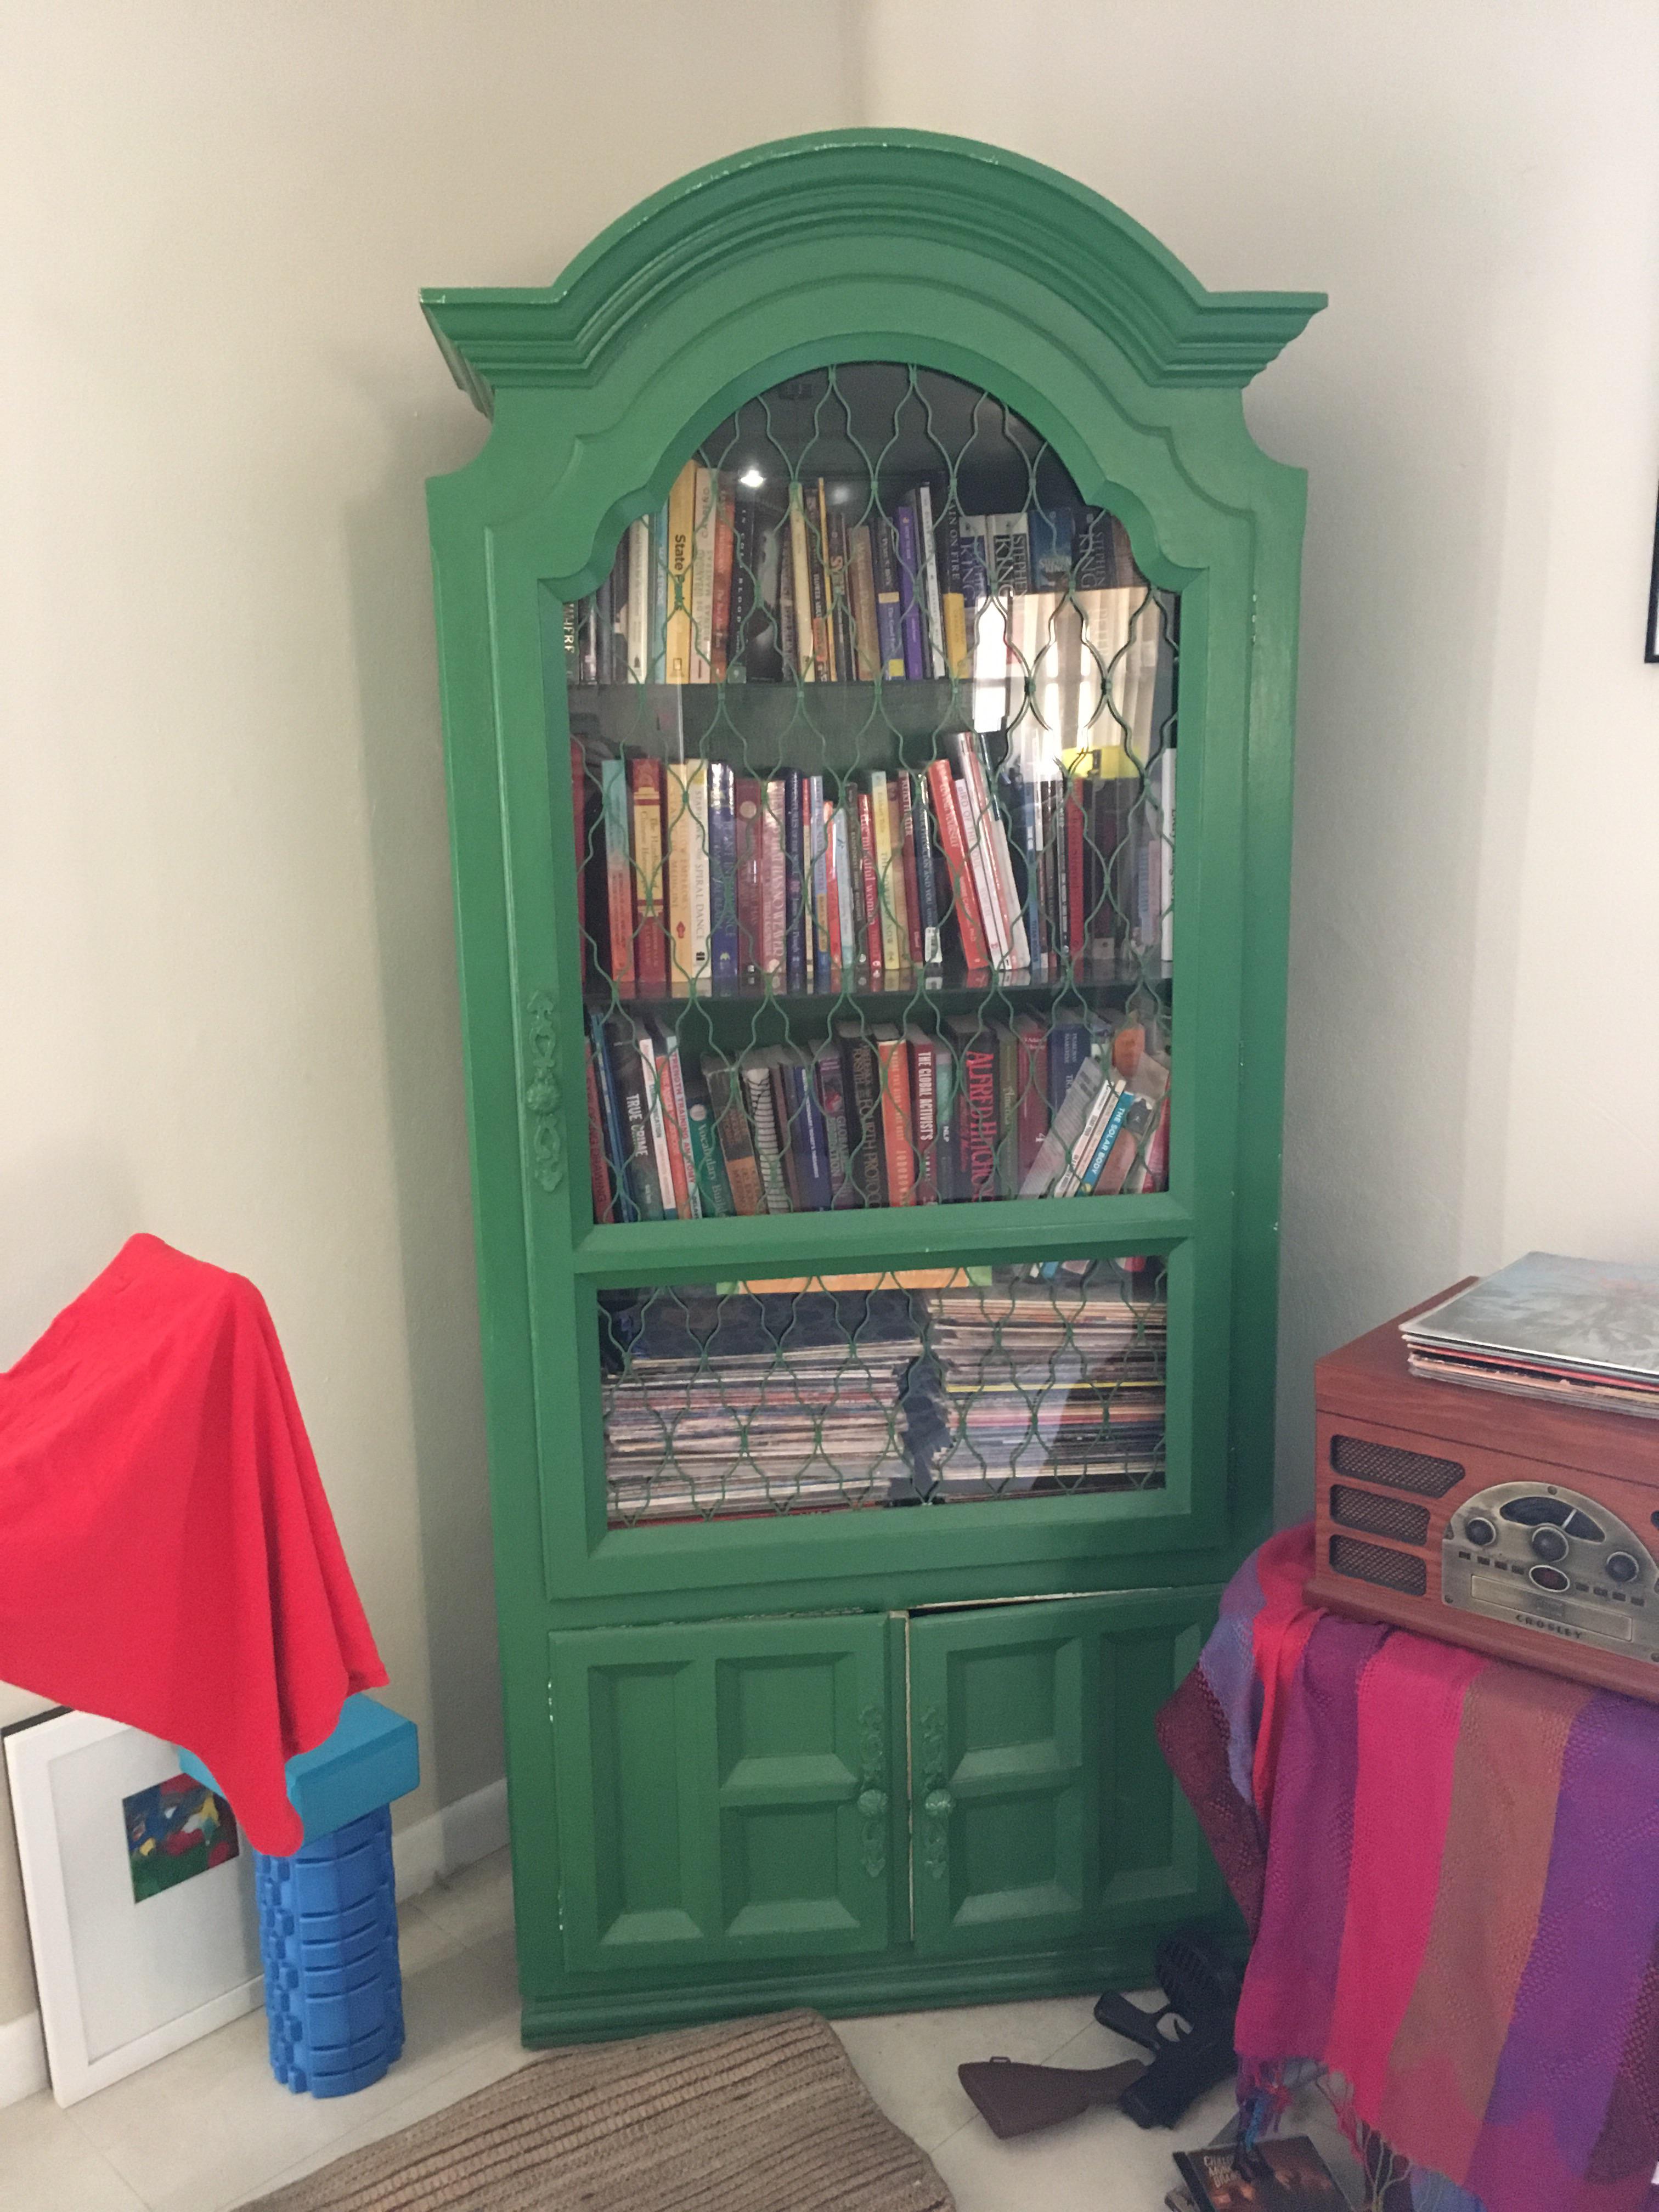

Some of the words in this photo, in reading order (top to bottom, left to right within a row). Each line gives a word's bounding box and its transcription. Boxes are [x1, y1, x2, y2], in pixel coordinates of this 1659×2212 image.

[675, 534, 686, 571] State
[951, 529, 959, 546] ON
[951, 551, 960, 580] FIRE
[960, 542, 976, 601] KING
[995, 537, 1014, 597] KING
[1013, 535, 1028, 598] STEPHEN
[1079, 533, 1097, 589] KING
[1093, 532, 1106, 586] STEPHEN
[901, 780, 910, 802] REIKI
[695, 791, 703, 840] STARHAWK
[862, 837, 876, 881] midful
[696, 864, 705, 899] SPIRAL
[772, 866, 784, 889] HAS
[923, 870, 932, 887] AND
[772, 890, 784, 909] NO
[696, 904, 705, 940] DANCE
[772, 911, 784, 957] WEAVER
[885, 924, 894, 944] NOW
[853, 1048, 864, 1084] FORSYTH
[918, 1052, 932, 1066] THE
[672, 1052, 682, 1094] TRENGTH
[677, 1098, 689, 1139] TRAINING
[918, 1068, 933, 1097] GLOBAL
[965, 1051, 995, 1120] ALFRED
[626, 1093, 642, 1121] TRUE
[858, 1099, 877, 1149] FOURTH
[919, 1098, 934, 1140] ACTIVIST'S
[1114, 1108, 1125, 1123] THE
[630, 1125, 648, 1157] CRIME
[698, 1123, 718, 1181] Vocabulary
[1101, 1124, 1118, 1152] SOLAR
[591, 1148, 607, 1203] DRAWING
[1092, 1153, 1105, 1175] BODY
[1516, 1615, 1583, 1639] CROSLEY
